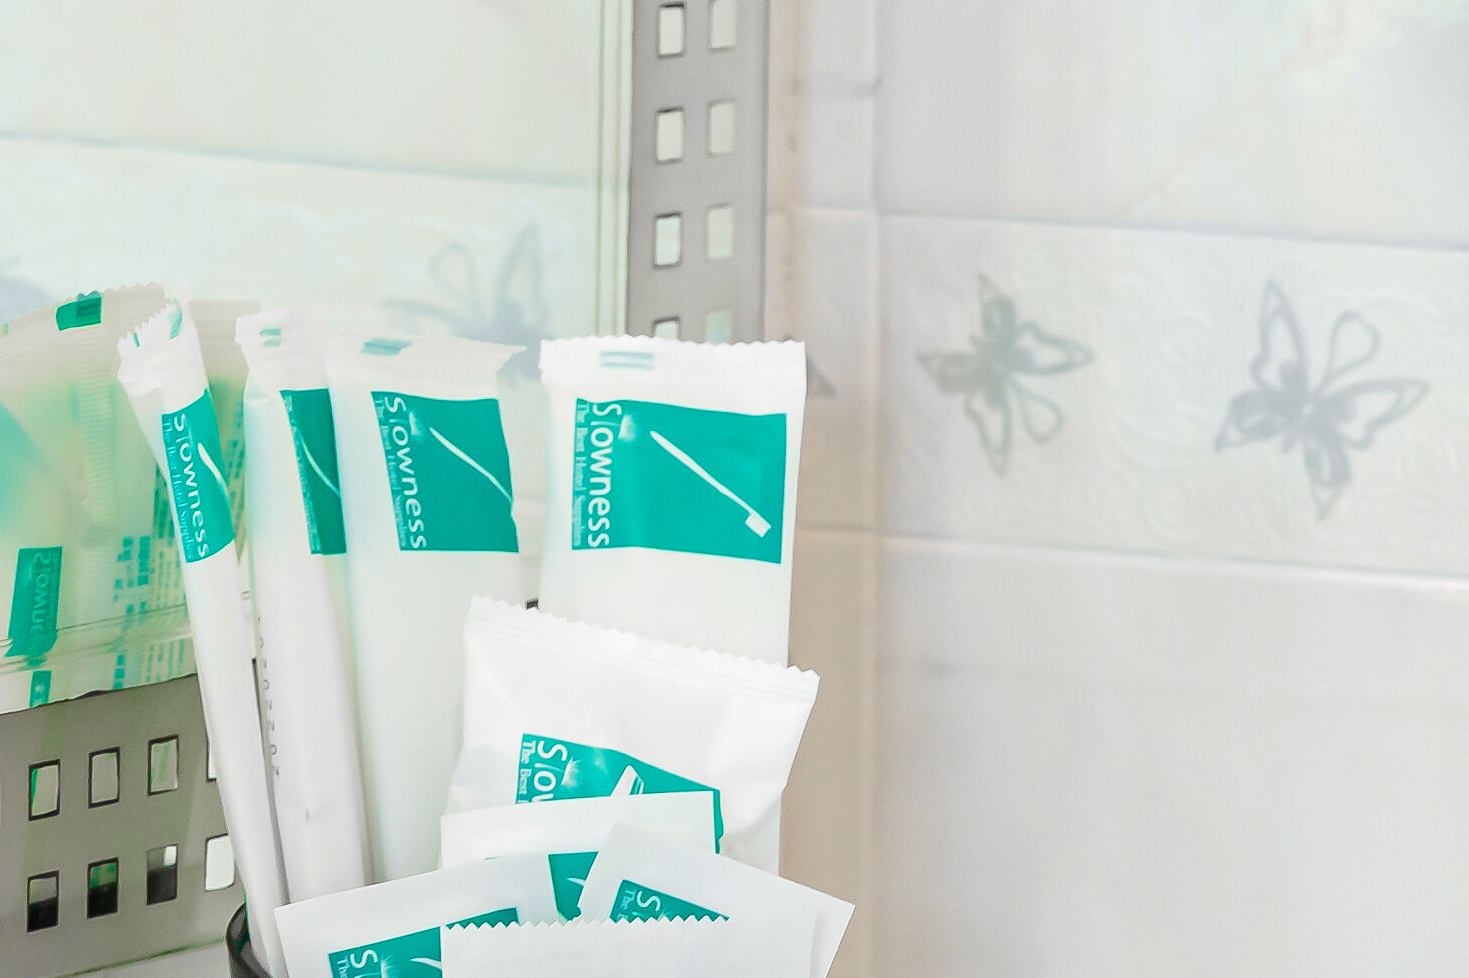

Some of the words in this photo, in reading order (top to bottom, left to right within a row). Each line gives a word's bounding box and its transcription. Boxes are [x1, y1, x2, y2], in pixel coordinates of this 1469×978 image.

[173, 413, 209, 558] Slowness
[383, 397, 427, 549] Slowness
[587, 403, 622, 548] Slowness
